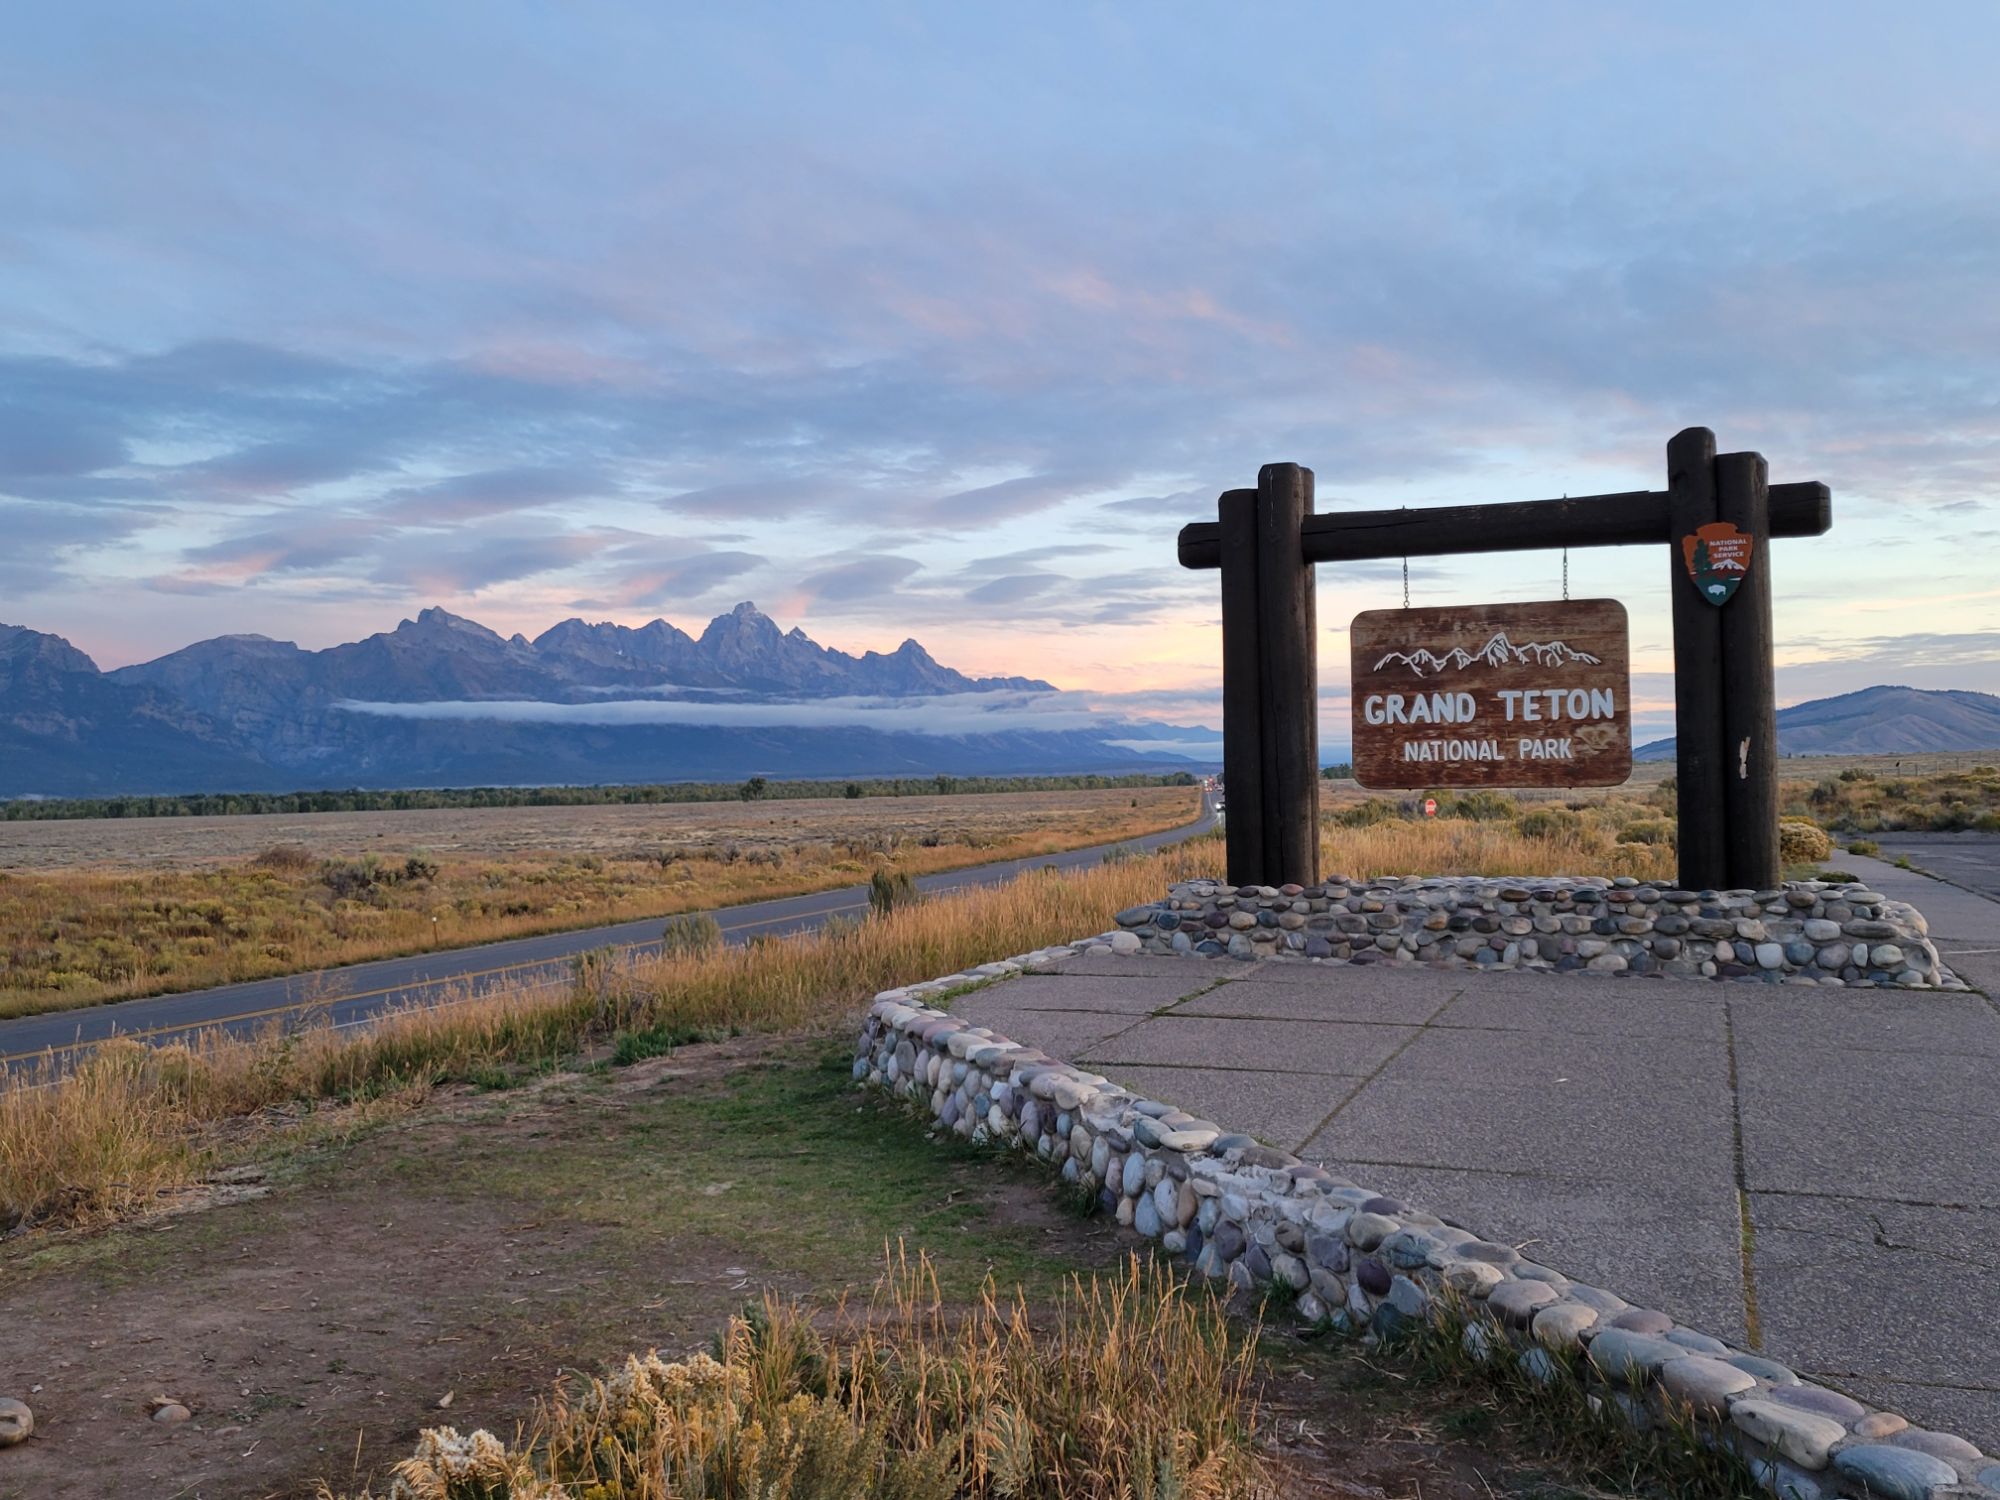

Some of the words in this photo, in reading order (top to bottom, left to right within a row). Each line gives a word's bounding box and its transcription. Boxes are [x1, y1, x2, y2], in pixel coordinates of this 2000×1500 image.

[1709, 538, 1747, 546] NATIONAL
[1365, 693, 1476, 724] GRAND
[1497, 688, 1614, 721] TETON
[1404, 739, 1505, 762] NATIONAL
[1519, 738, 1573, 760] PARK
